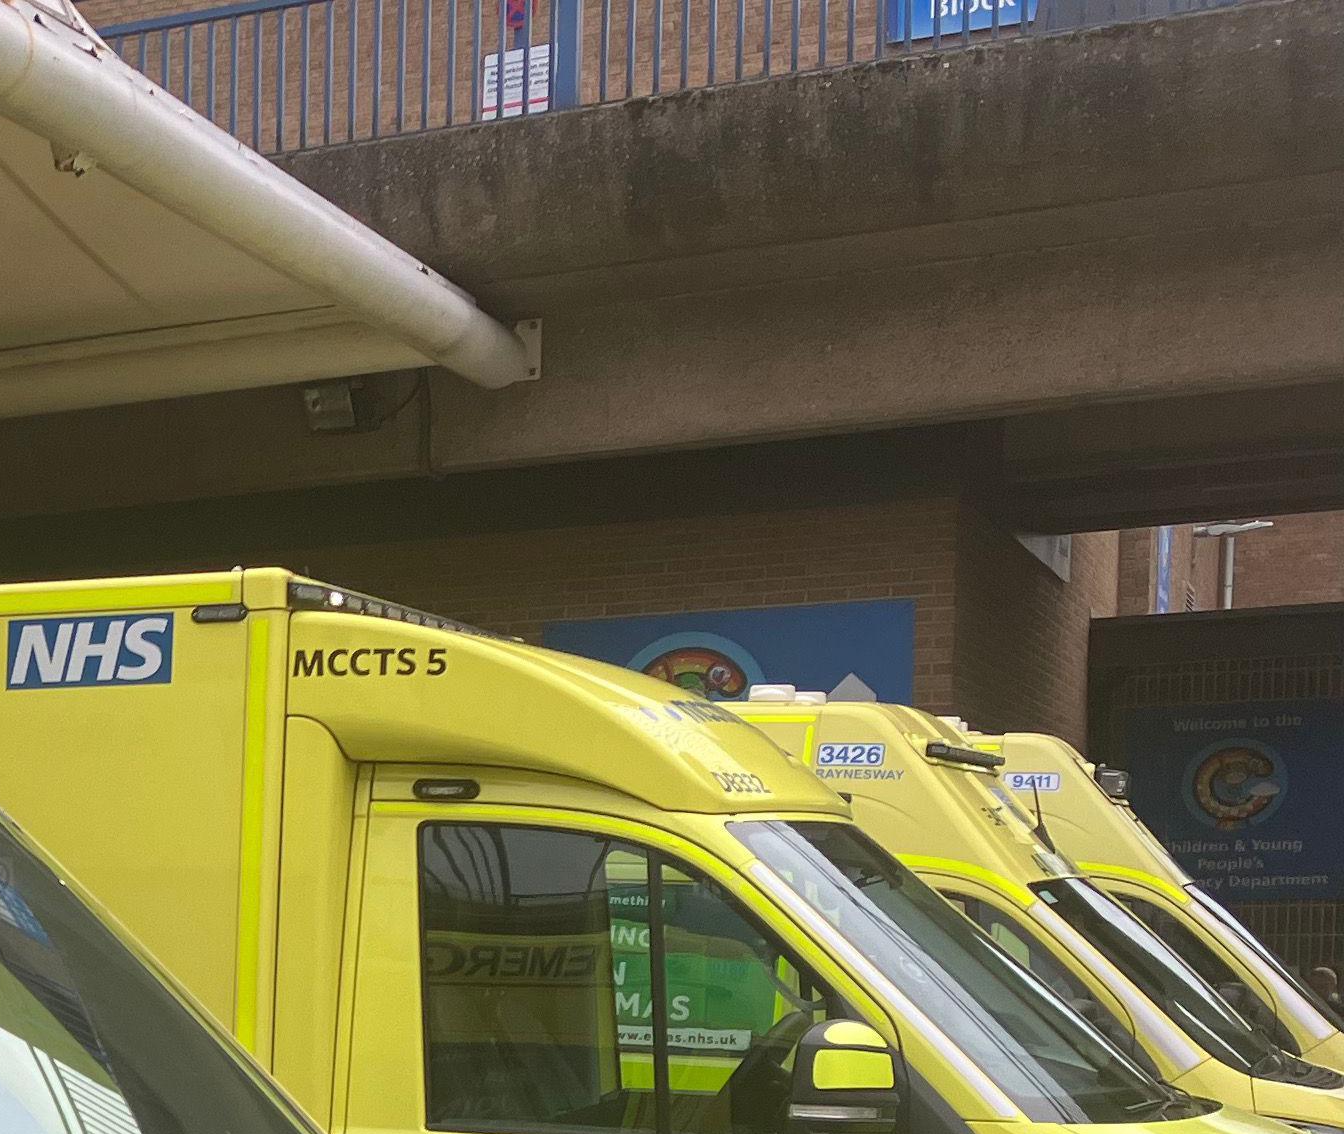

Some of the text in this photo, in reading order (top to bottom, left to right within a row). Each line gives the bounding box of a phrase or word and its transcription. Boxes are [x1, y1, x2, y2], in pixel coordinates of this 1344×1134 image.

[10, 617, 169, 685] NHS
[292, 647, 448, 678] MCCTS 5
[820, 744, 882, 765] 3426
[816, 768, 905, 781] RAYNESWAY
[1012, 774, 1052, 788] 9411
[1165, 839, 1229, 852] hildren
